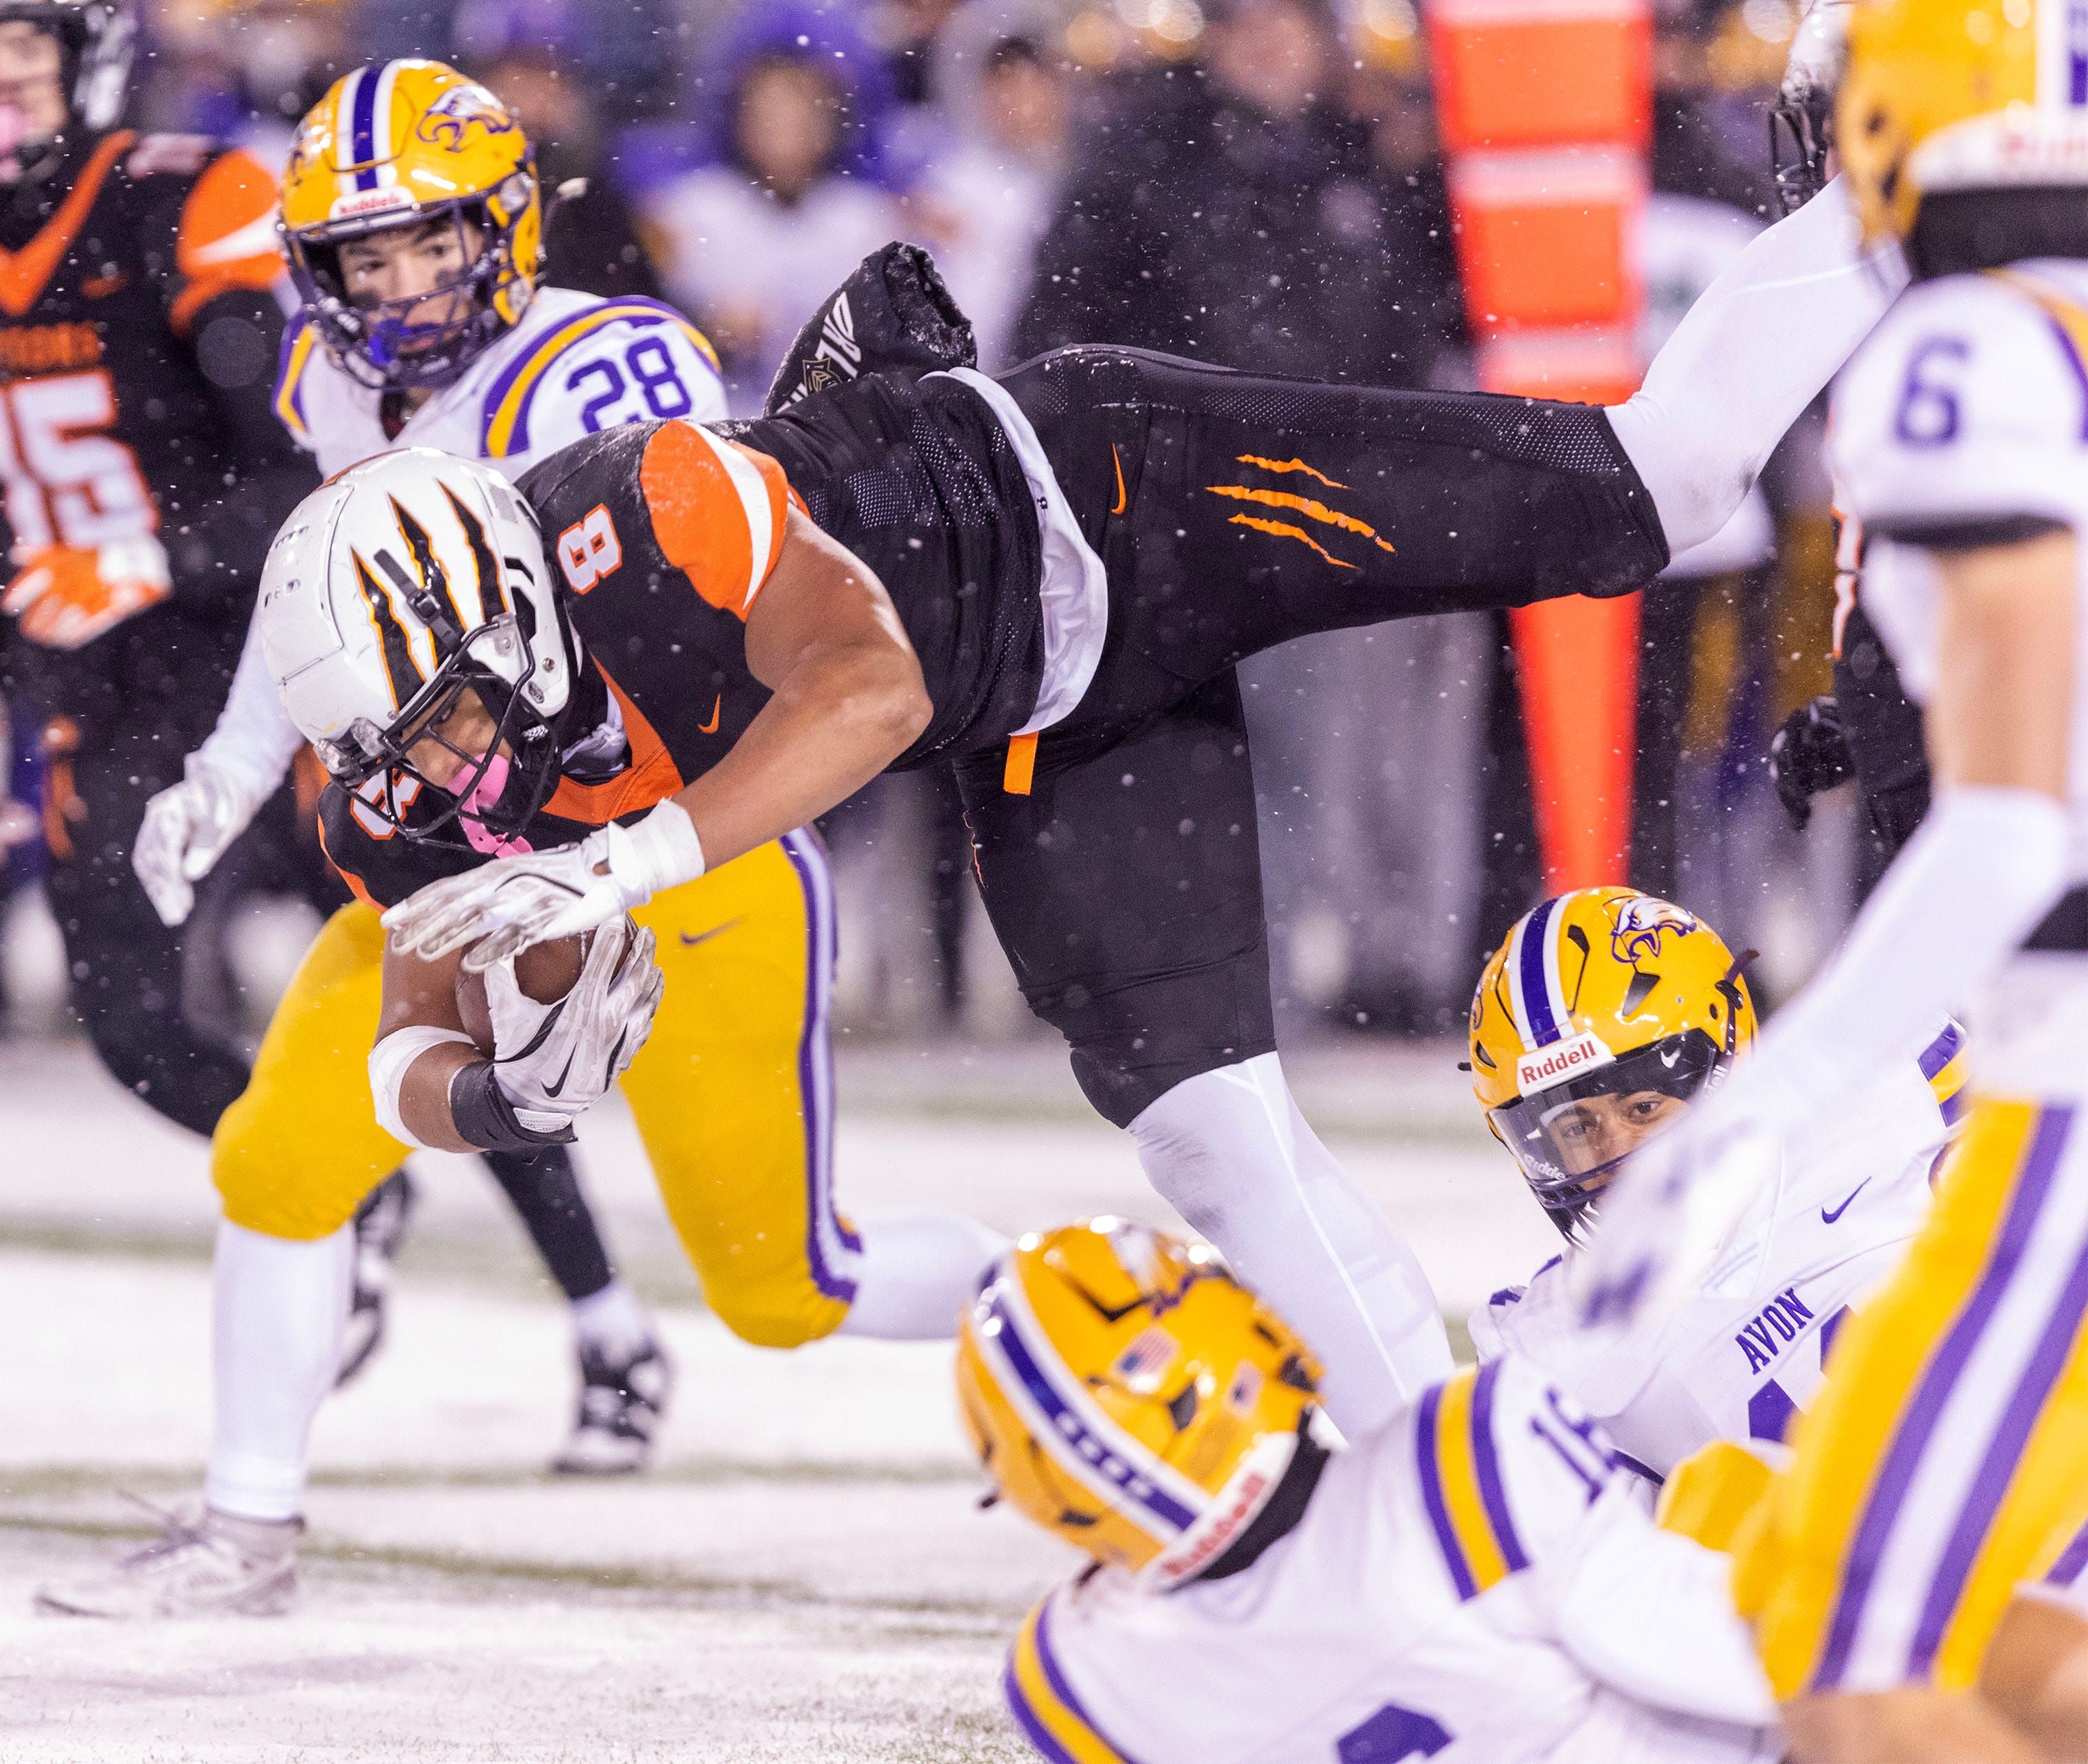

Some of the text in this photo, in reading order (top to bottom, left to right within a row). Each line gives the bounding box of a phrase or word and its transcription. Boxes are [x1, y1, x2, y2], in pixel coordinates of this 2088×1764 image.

[567, 336, 692, 434] 28
[1895, 333, 1971, 449] 6
[556, 503, 622, 595] 8
[1521, 1040, 1596, 1084] Riddell
[1524, 1153, 1566, 1181] Ridde
[1734, 1286, 1814, 1376] AVON
